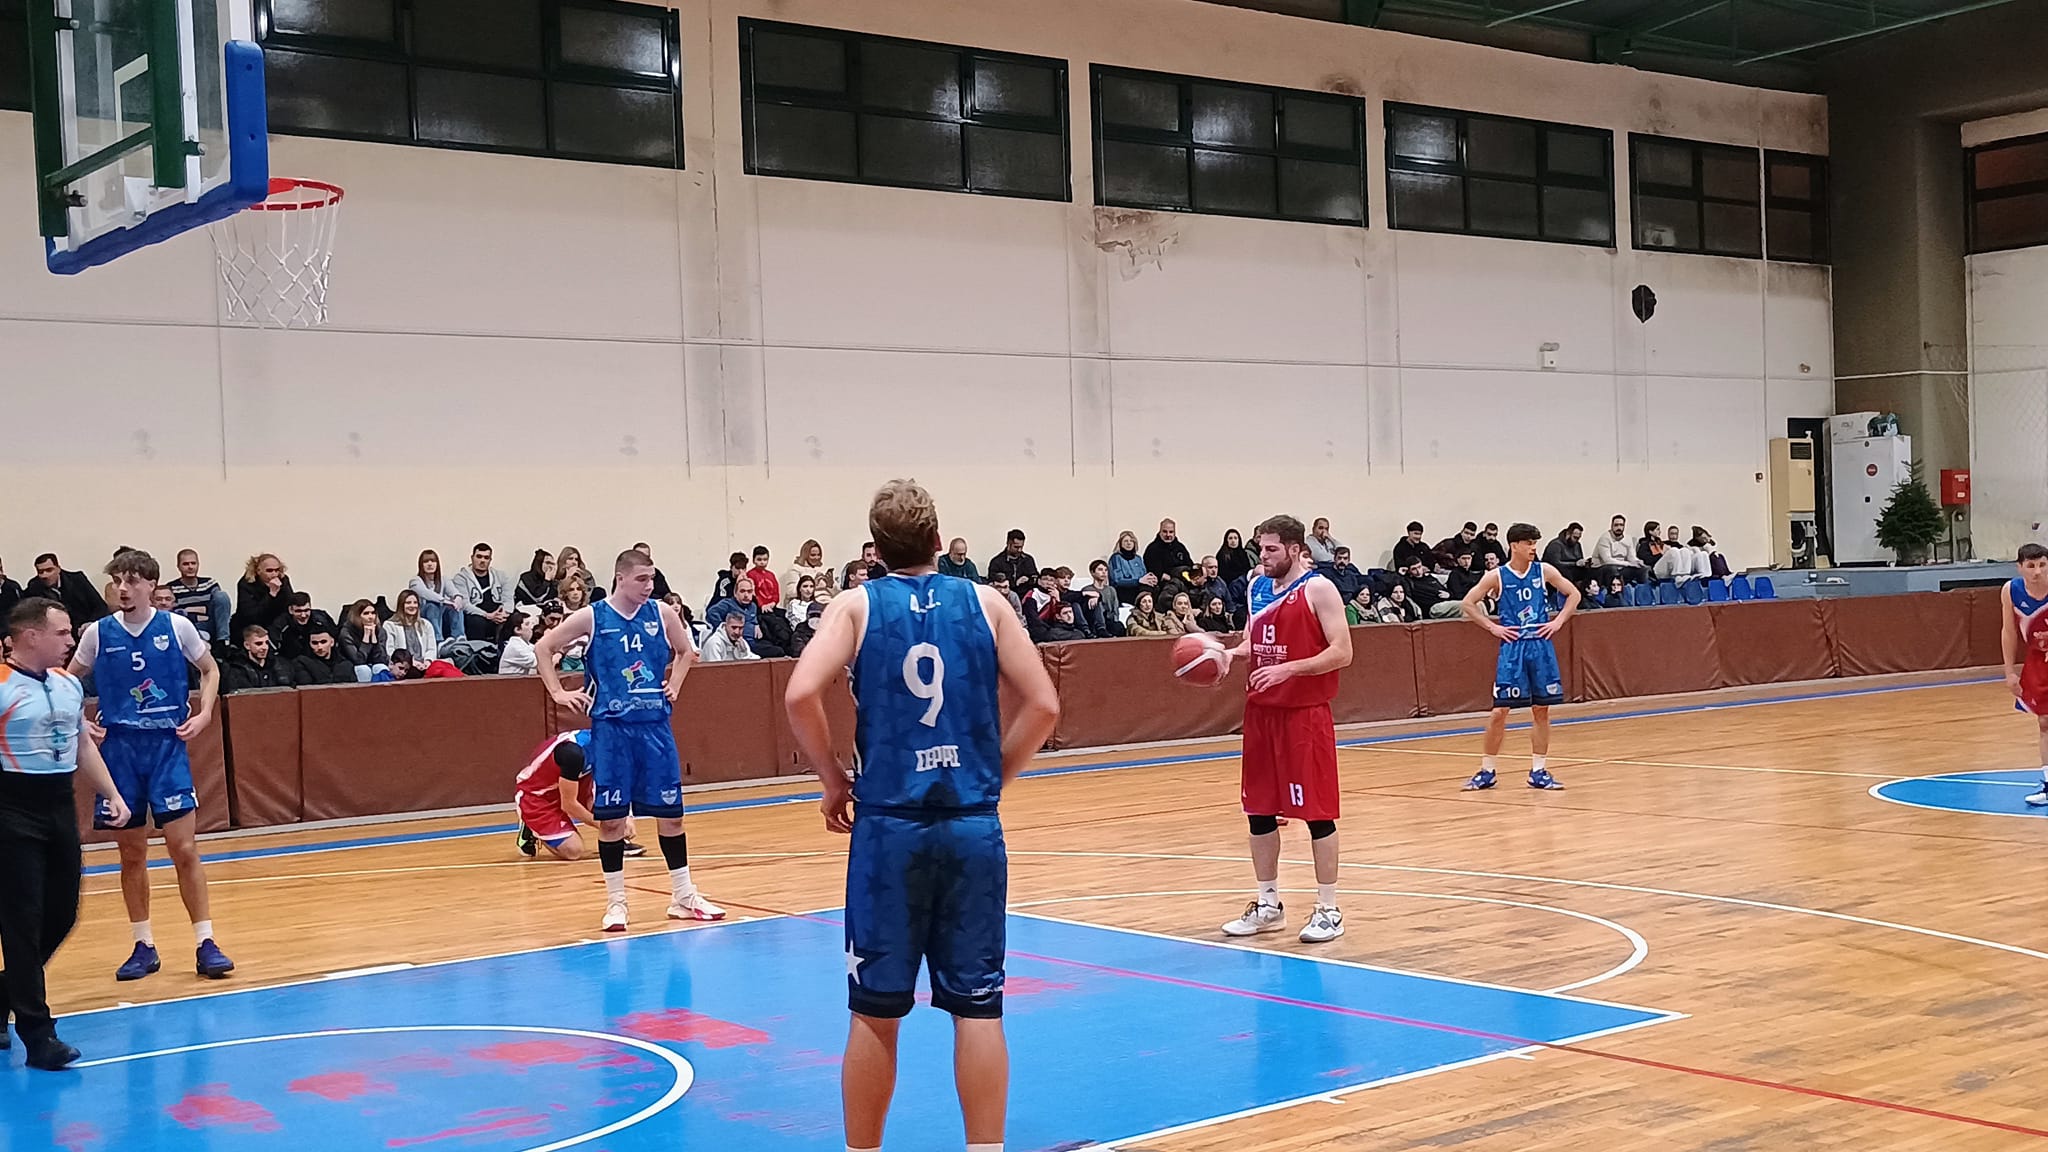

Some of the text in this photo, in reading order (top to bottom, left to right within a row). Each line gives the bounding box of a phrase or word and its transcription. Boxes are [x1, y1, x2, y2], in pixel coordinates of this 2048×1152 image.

[1516, 587, 1532, 602] 10
[620, 633, 644, 653] 14
[1262, 624, 1276, 644] 13
[131, 651, 146, 671] 5
[902, 642, 945, 728] 9
[1505, 687, 1521, 699] 10
[601, 789, 622, 806] 14
[1289, 782, 1305, 807] 13
